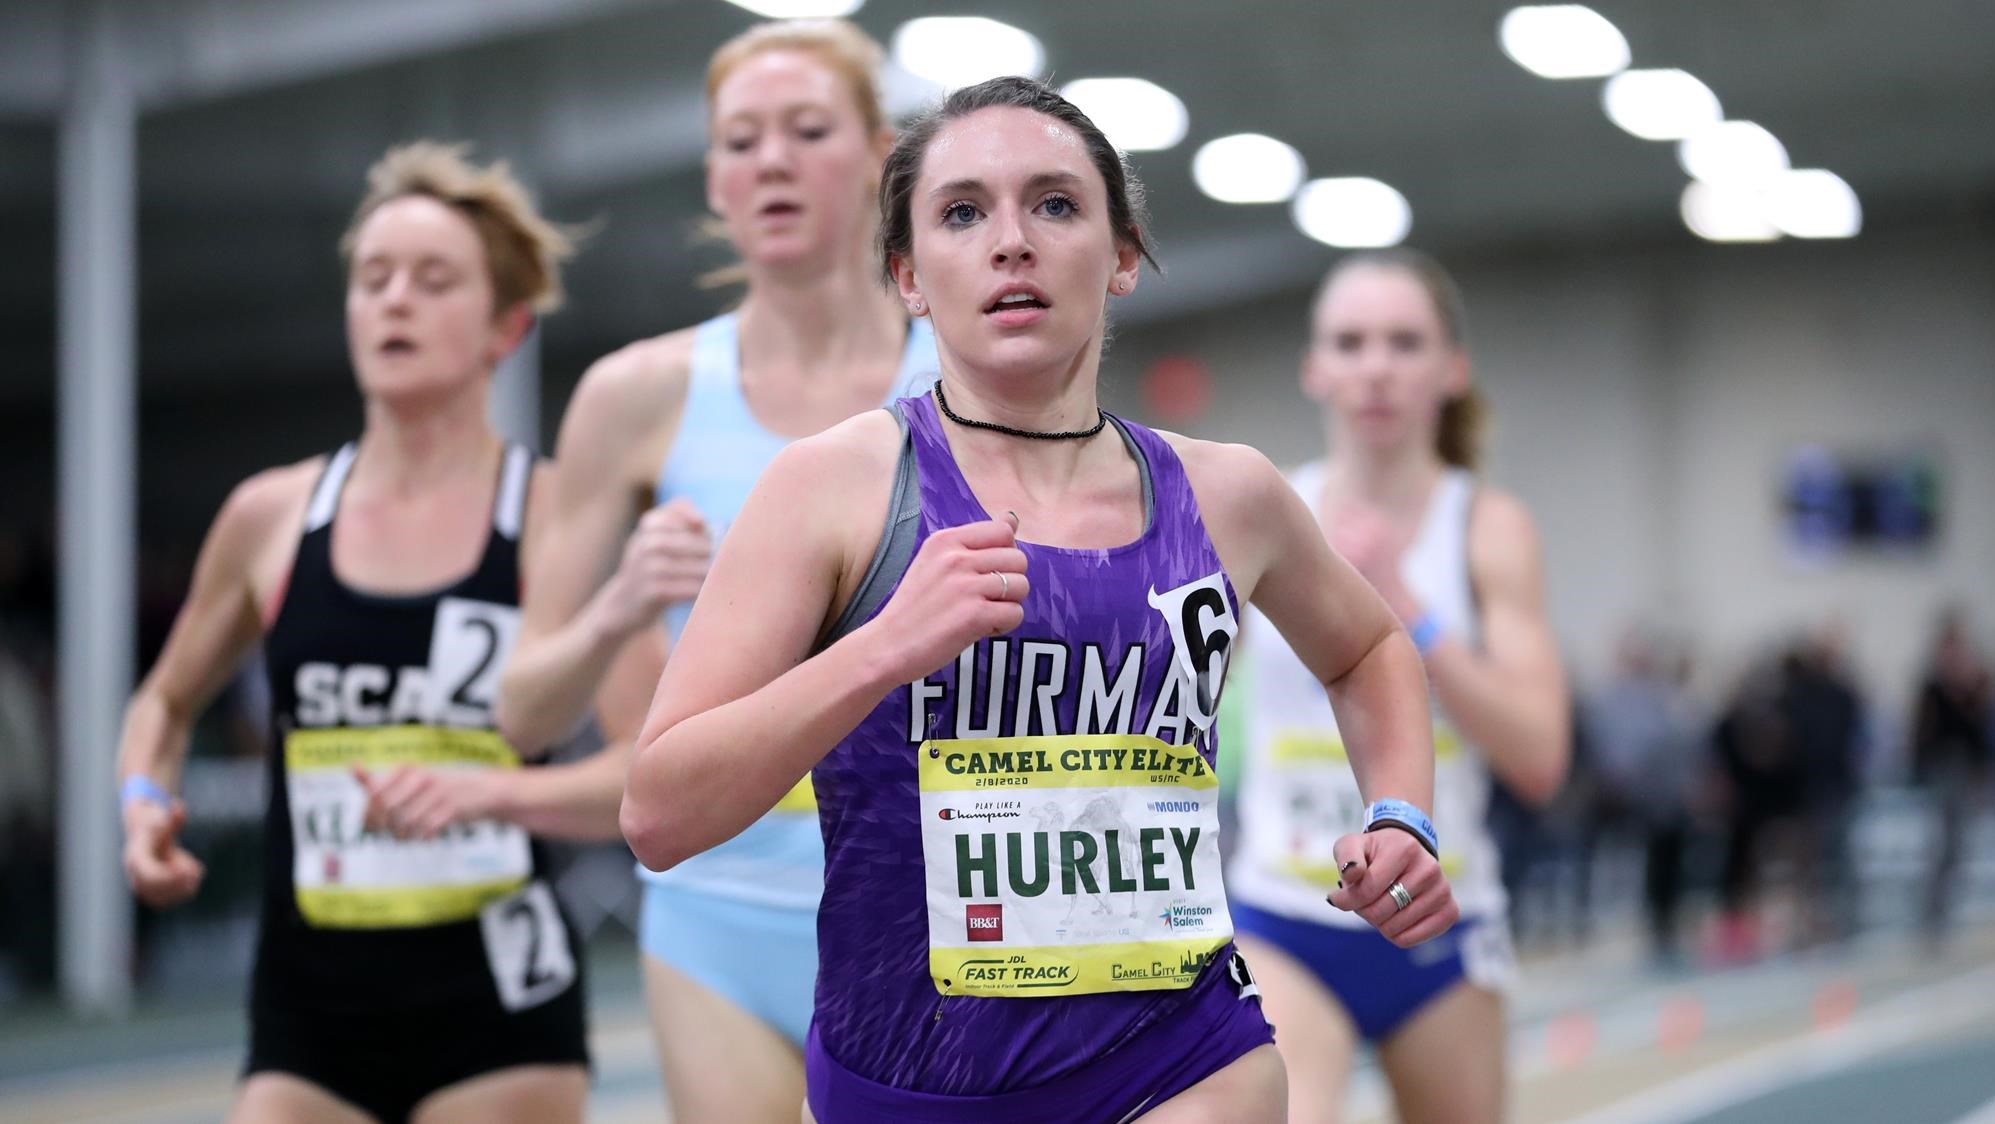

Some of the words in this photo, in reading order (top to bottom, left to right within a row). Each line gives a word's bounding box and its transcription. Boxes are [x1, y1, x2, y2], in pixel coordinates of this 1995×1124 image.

[1181, 586, 1231, 718] 6
[449, 616, 500, 710] 2
[908, 638, 1214, 752] FURMA
[945, 750, 1053, 775] CAMEL
[1060, 749, 1127, 771] CITY
[1131, 749, 1206, 777] ELITE
[975, 777, 1029, 787] 2/8/2020
[975, 802, 993, 810] PLAY
[996, 801, 1013, 809] LIKE
[1016, 800, 1021, 808] A
[1154, 801, 1199, 813] MONDO
[938, 808, 1021, 823] Champion
[955, 827, 1200, 898] HURLEY
[1173, 905, 1212, 915] Winston
[969, 917, 1000, 929] BB&T
[1173, 917, 1204, 927] Salem
[503, 905, 555, 991] 2
[1007, 956, 1027, 964] JDL
[965, 967, 1008, 981] FAST
[1013, 966, 1071, 979] TRACK
